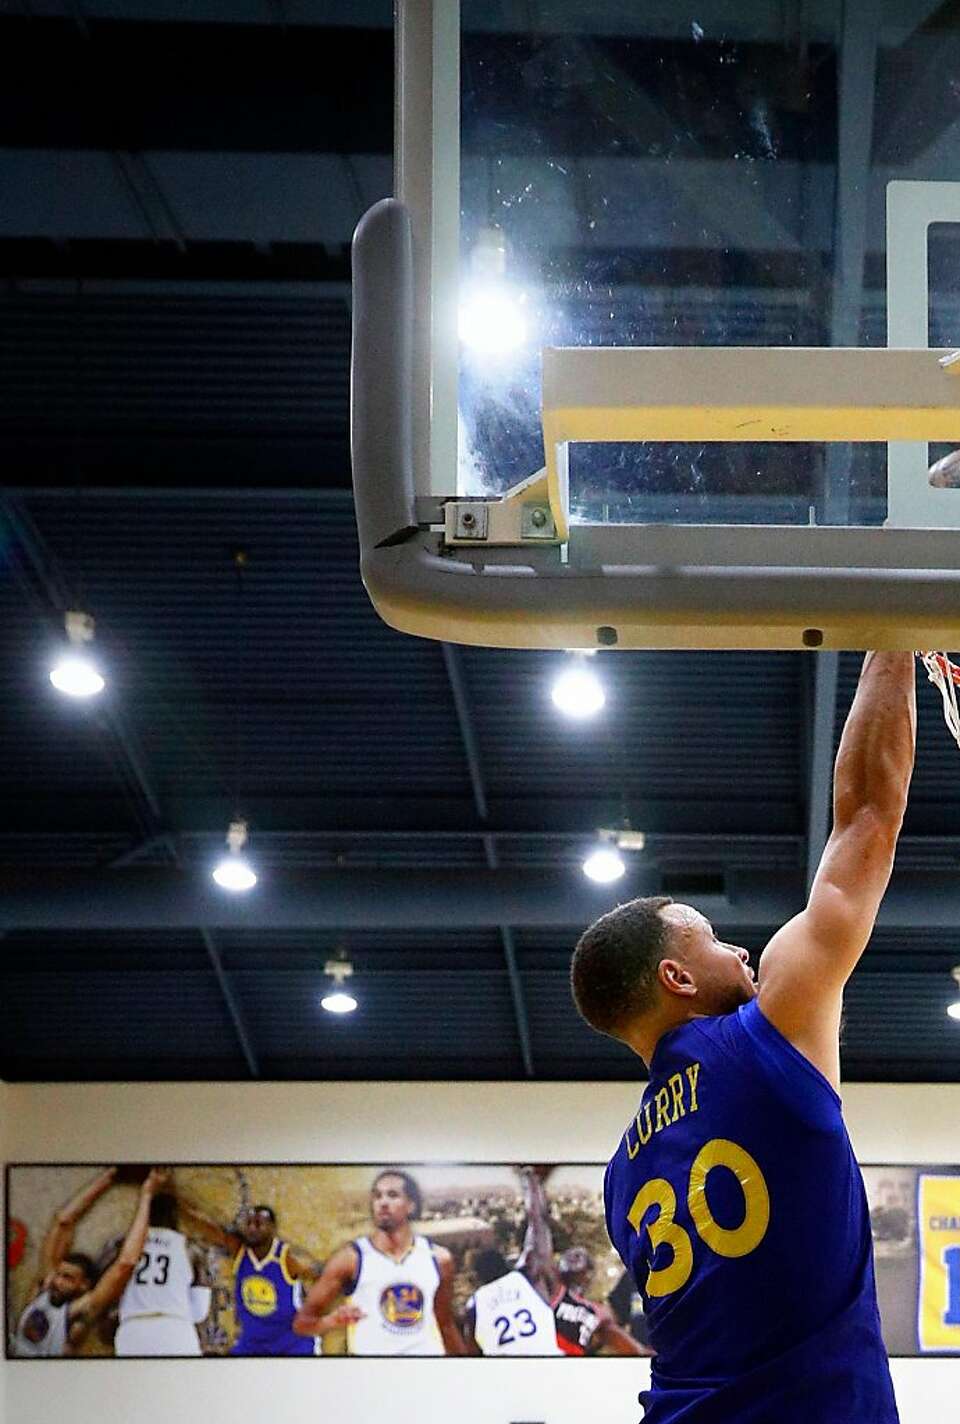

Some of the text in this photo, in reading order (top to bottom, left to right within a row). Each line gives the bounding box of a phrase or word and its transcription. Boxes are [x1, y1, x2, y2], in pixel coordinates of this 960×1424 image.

[626, 1138, 770, 1298] 30
[136, 1253, 169, 1285] 23
[493, 1308, 538, 1346] 23
